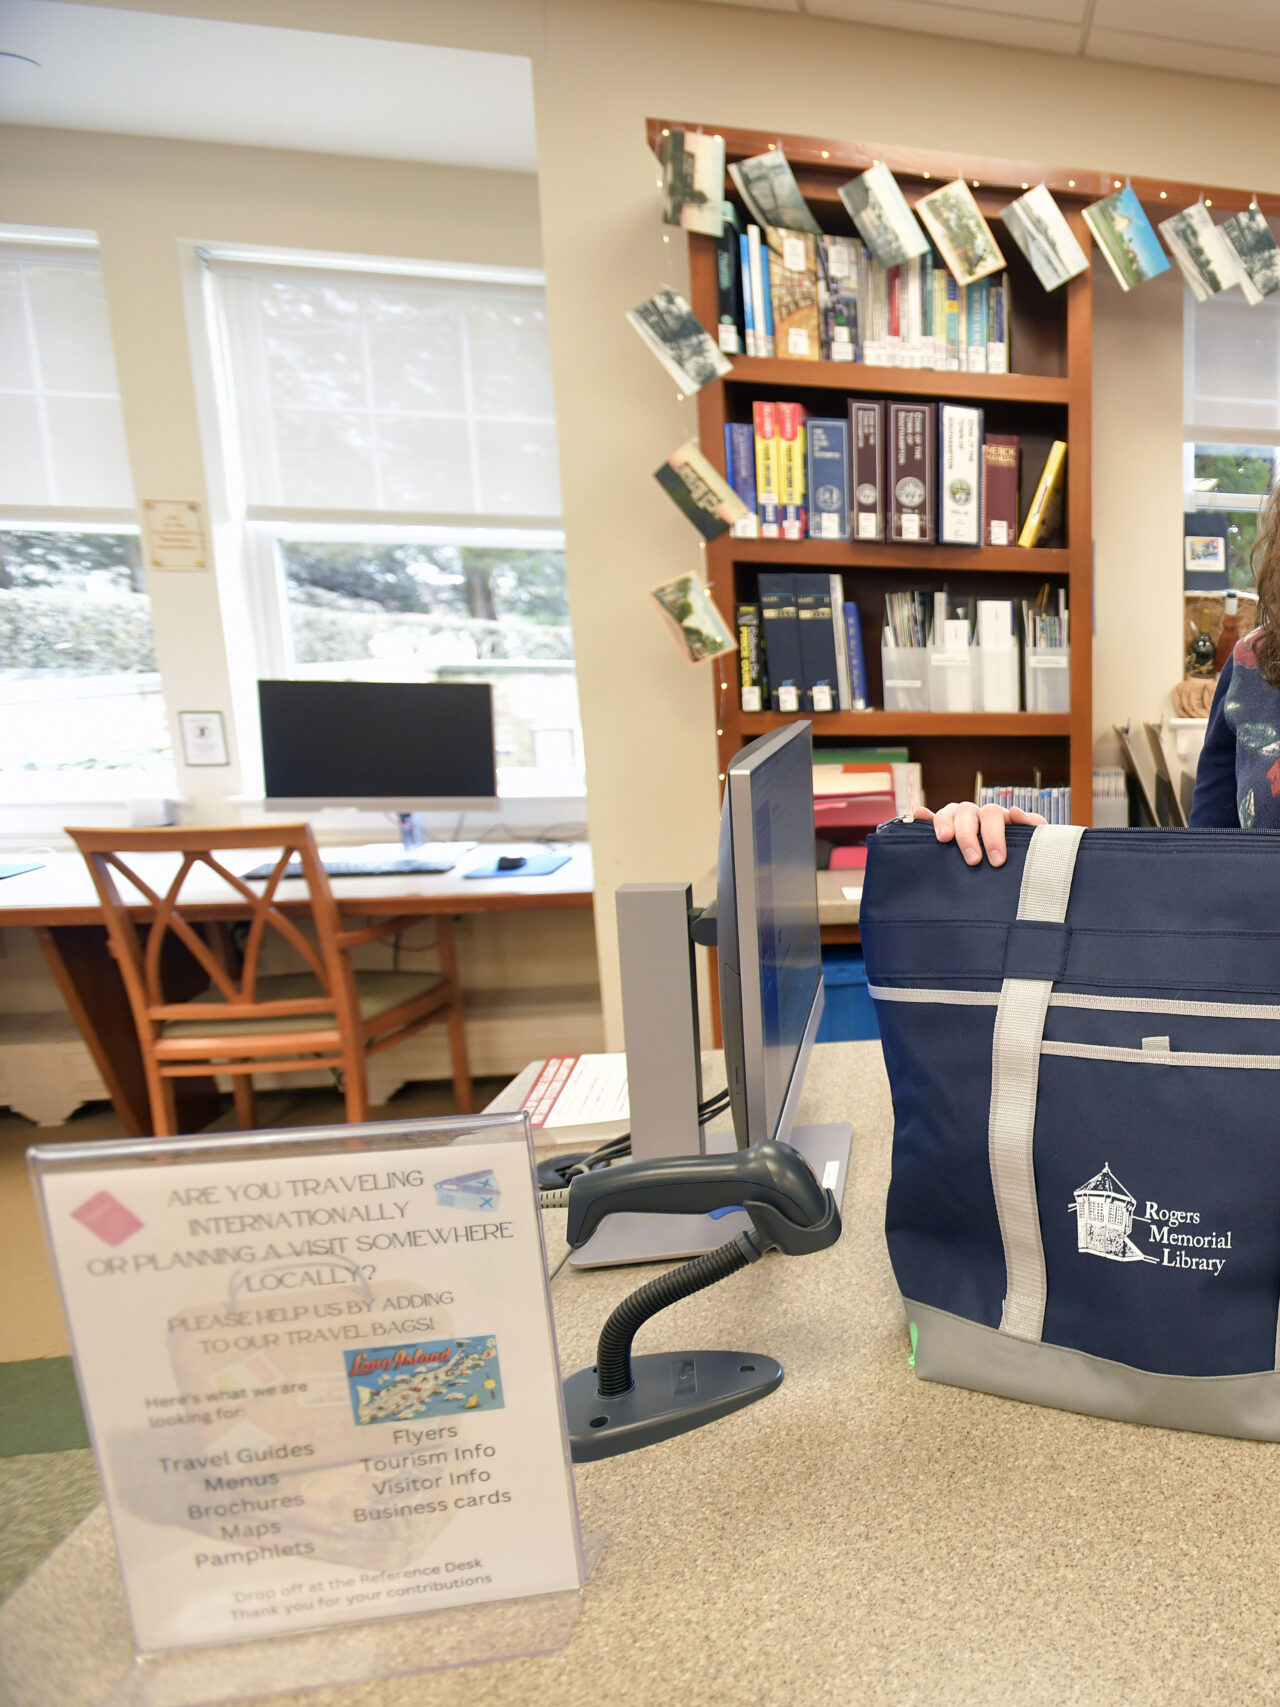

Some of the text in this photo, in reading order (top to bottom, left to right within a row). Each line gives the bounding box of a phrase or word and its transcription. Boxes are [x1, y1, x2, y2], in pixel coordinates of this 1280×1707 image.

[167, 1170, 424, 1207] ARE YOU TRAVELING
[188, 1201, 410, 1236] INTERNATIONALLY
[1144, 1201, 1201, 1227] Rogers
[86, 1222, 514, 1277] OR PLANNING A VISIT SOMEWHERE
[1149, 1225, 1232, 1249] Memorial
[1162, 1248, 1226, 1276] Library
[245, 1265, 377, 1293] LOCALLY?
[168, 1291, 454, 1333] PLEASE HELP US BY ADDING
[198, 1317, 435, 1354] TO OUR TRAVEL BAGS!
[348, 1347, 452, 1377] Long Island
[144, 1382, 309, 1409] Here's what we are
[149, 1411, 213, 1429] looking
[393, 1426, 459, 1446] Flyers
[159, 1443, 316, 1473] Travel Guides
[360, 1443, 496, 1473] Tourism Info
[204, 1473, 280, 1492] Menus
[373, 1468, 491, 1496] Visitor Info
[188, 1494, 306, 1520] Brochures
[353, 1489, 512, 1523] Business cards
[221, 1521, 282, 1540] Maps
[195, 1541, 316, 1568] Pamphlets
[234, 1557, 484, 1605] Drop off at the Reference Desk
[231, 1573, 493, 1622] Thank you for your contributions
